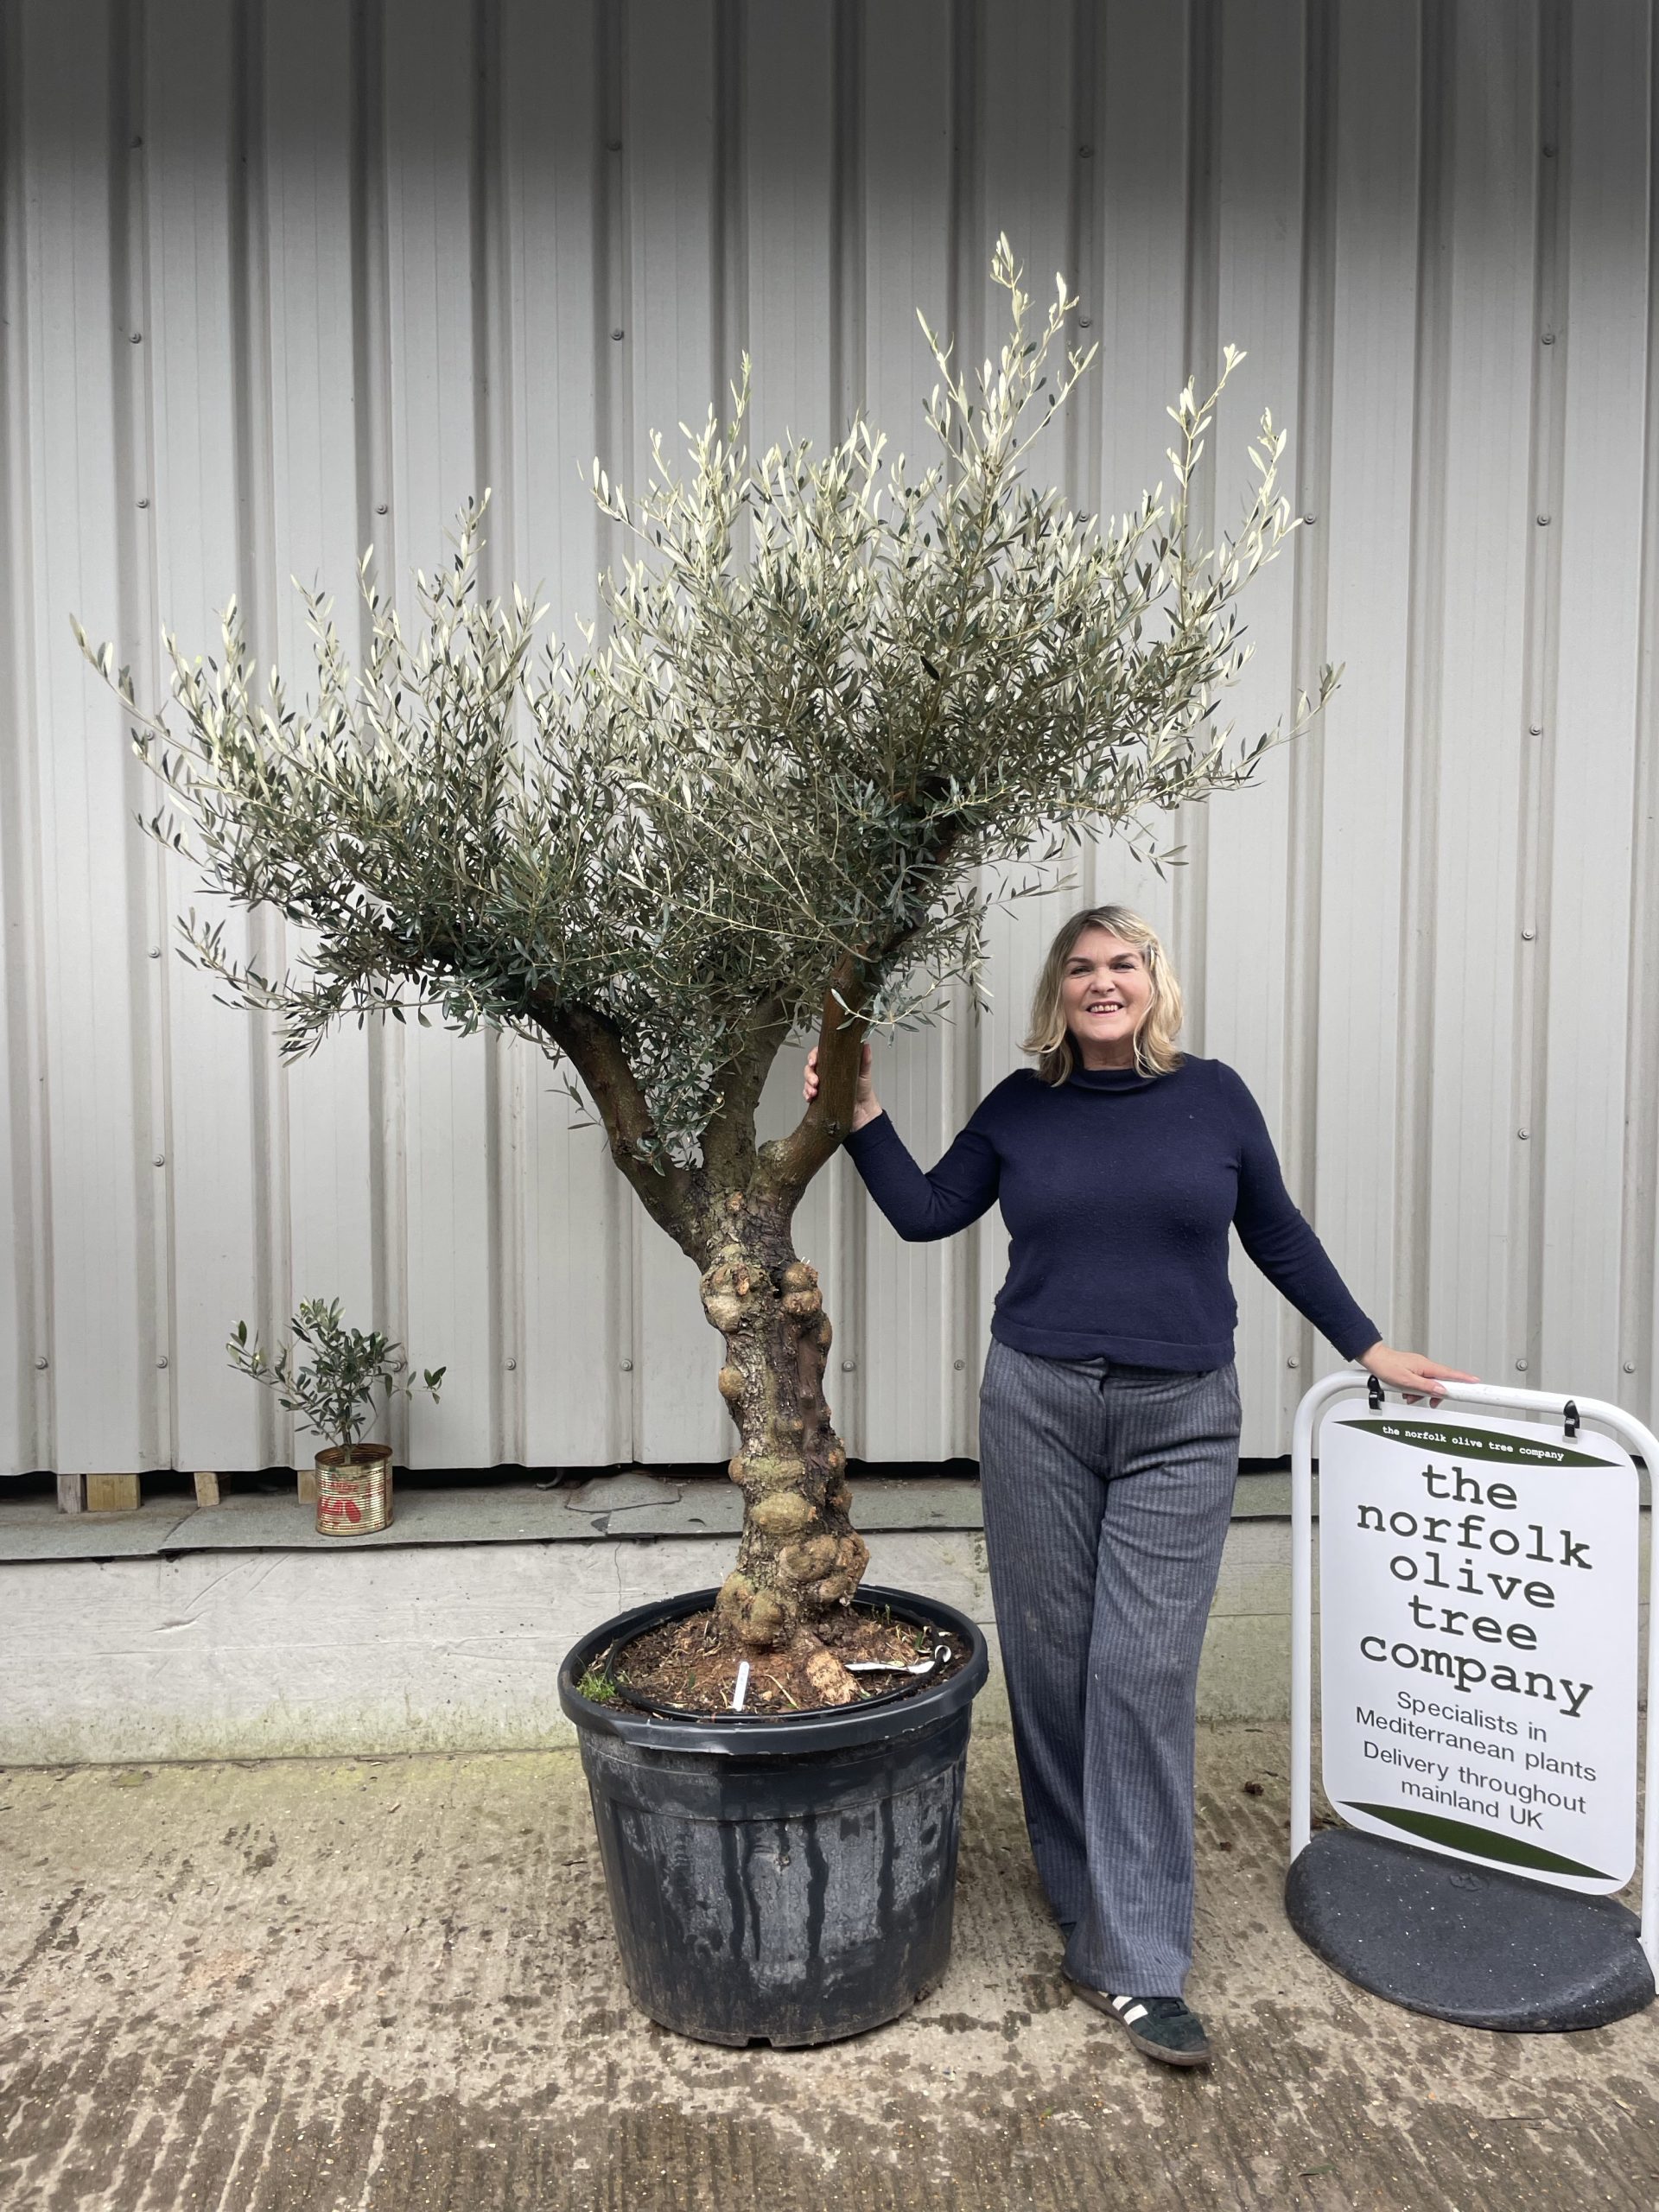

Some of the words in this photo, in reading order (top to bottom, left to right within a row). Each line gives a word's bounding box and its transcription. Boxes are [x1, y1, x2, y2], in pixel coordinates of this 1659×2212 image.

[1382, 1426, 1400, 1436] the
[1405, 1430, 1447, 1443] norfolk
[1452, 1437, 1483, 1448] olive
[1489, 1441, 1514, 1452] tree
[1519, 1446, 1565, 1462] company
[1422, 1464, 1517, 1510] the
[1357, 1504, 1592, 1570] norfolk
[1390, 1552, 1555, 1609] olive
[1408, 1595, 1537, 1650] tree
[1361, 1637, 1593, 1718] company
[1356, 1706, 1515, 1762] Mediterranean
[1525, 1751, 1597, 1782] plants
[1397, 1691, 1518, 1736] Specialists
[1529, 1721, 1547, 1743] in
[1363, 1740, 1449, 1782] Delivery
[1459, 1766, 1586, 1815] throughout
[1402, 1780, 1499, 1819] mainland
[1510, 1805, 1544, 1830] UK
